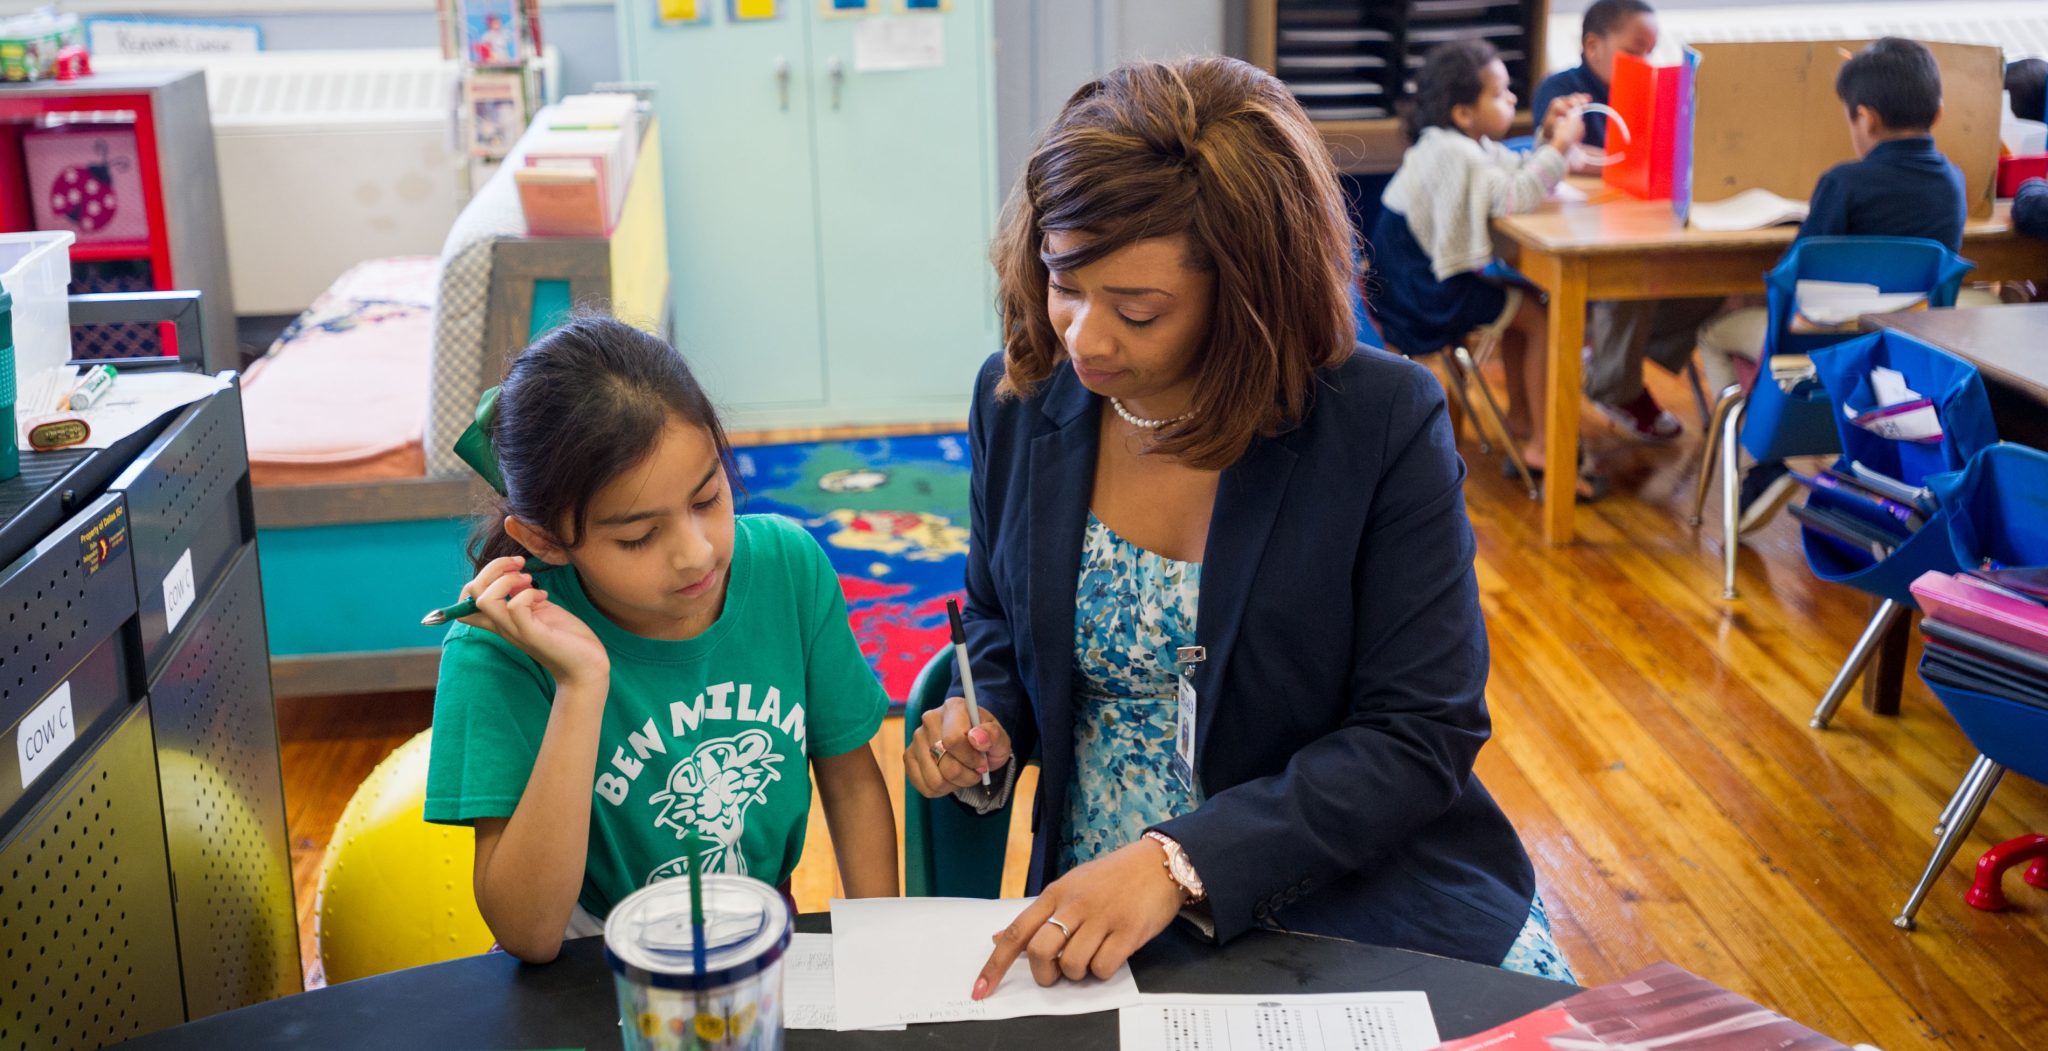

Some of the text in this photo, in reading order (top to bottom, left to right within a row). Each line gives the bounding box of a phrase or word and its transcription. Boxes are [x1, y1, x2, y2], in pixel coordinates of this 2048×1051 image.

[168, 568, 192, 612] COW C
[25, 705, 69, 761] COW C
[594, 717, 668, 807] BEN
